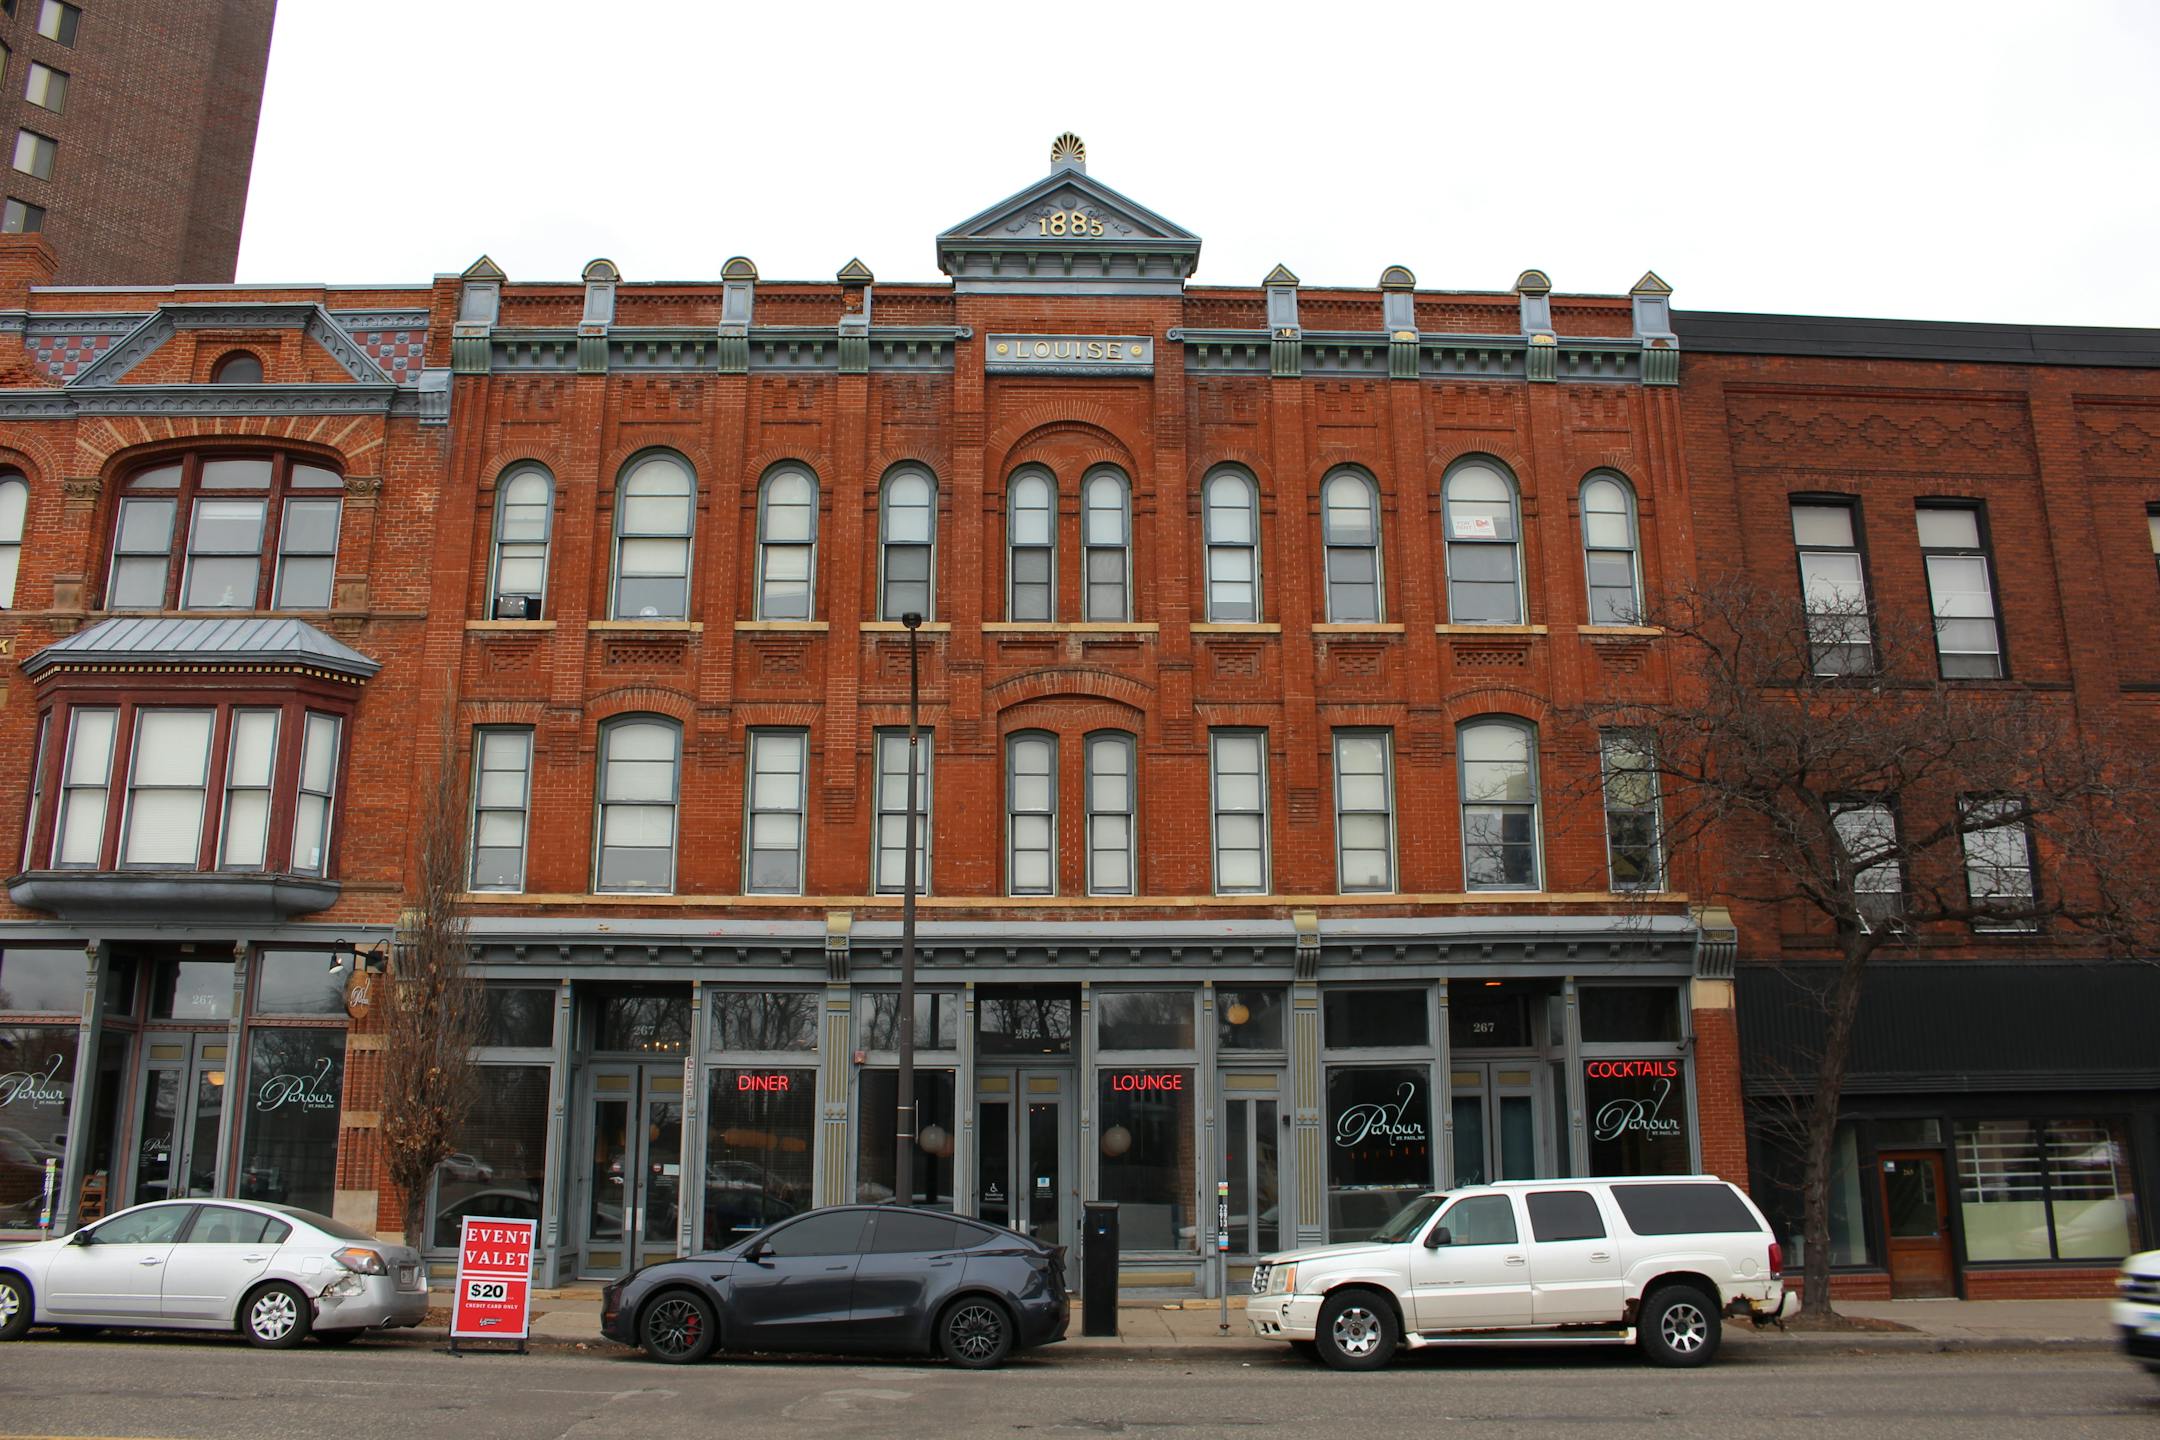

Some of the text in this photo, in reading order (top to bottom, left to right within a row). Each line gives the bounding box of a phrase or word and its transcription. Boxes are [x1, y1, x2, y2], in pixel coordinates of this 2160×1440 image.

[1039, 210, 1104, 236] 1885
[1016, 341, 1122, 359] LOUISE
[633, 1025, 656, 1036] 267
[1015, 1029, 1039, 1039] 267
[1473, 1022, 1495, 1033] 267
[1587, 1061, 1678, 1078] COCKTAILS
[738, 1075, 789, 1091] DINER
[1112, 1074, 1183, 1091] LOUNGE
[1336, 1081, 1425, 1147] Parlour
[1594, 1078, 1680, 1141] Parlour
[467, 1228, 531, 1245] EVENT
[465, 1250, 529, 1266] VALET
[471, 1283, 504, 1298] $20
